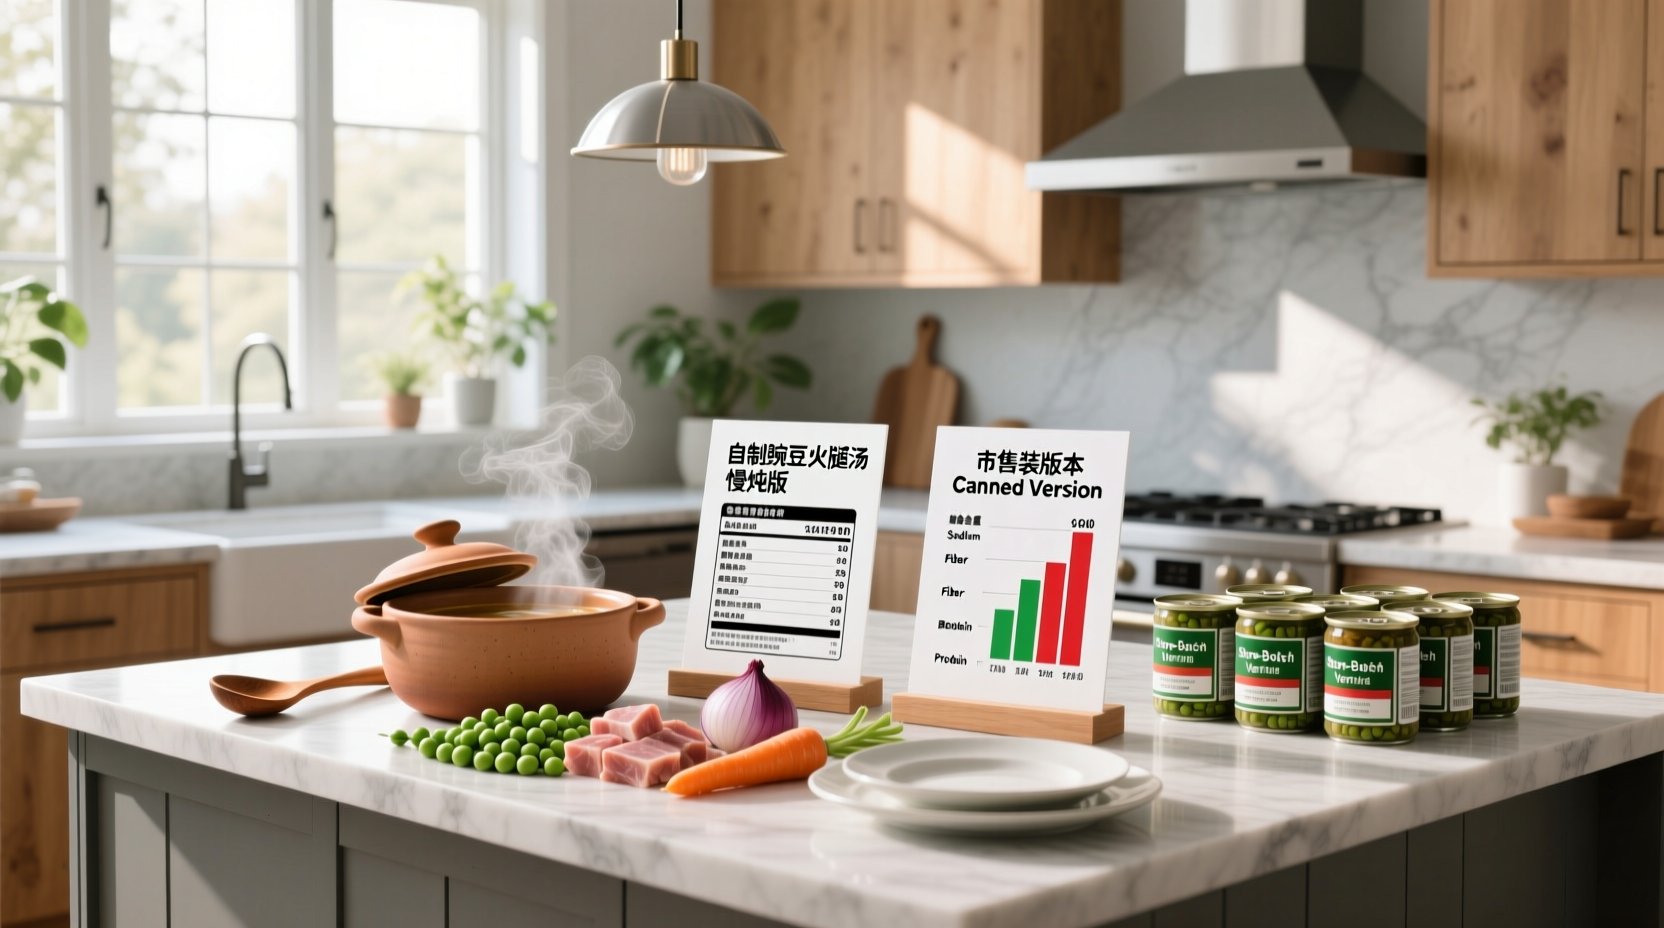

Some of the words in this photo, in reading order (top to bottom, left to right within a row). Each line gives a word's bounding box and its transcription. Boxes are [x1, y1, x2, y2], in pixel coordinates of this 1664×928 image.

[977, 449, 1085, 477] 市售装版本
[952, 475, 1024, 496] Canned
[1029, 478, 1103, 499] Version
